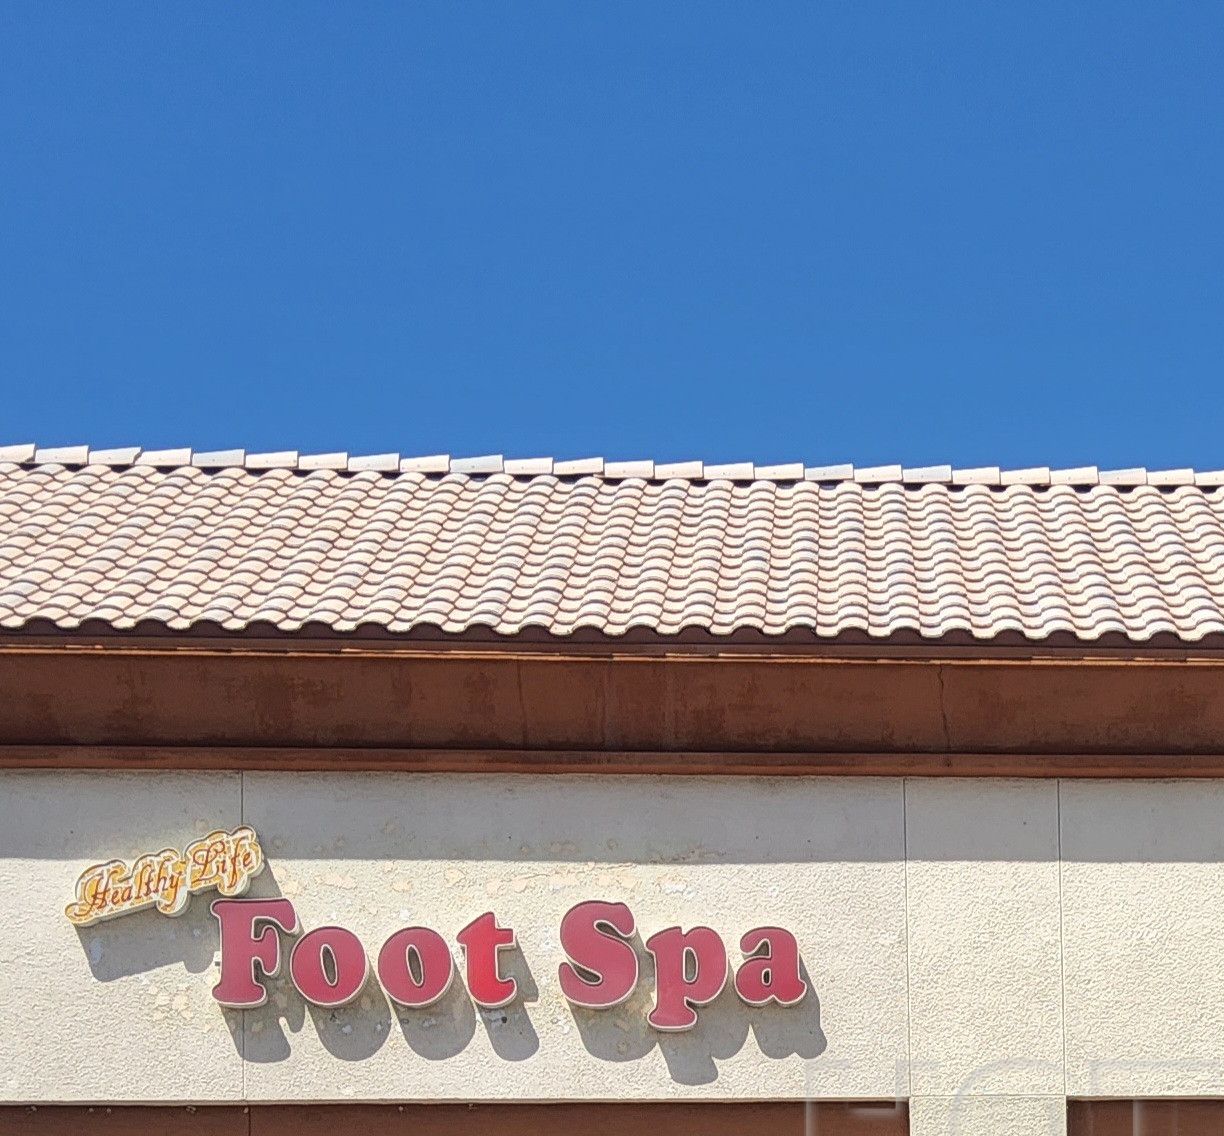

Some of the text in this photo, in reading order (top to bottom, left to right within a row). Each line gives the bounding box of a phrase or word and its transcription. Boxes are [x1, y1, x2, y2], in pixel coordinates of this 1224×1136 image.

[74, 838, 251, 917] Healthy Life
[211, 898, 807, 1031] Foot Spa
